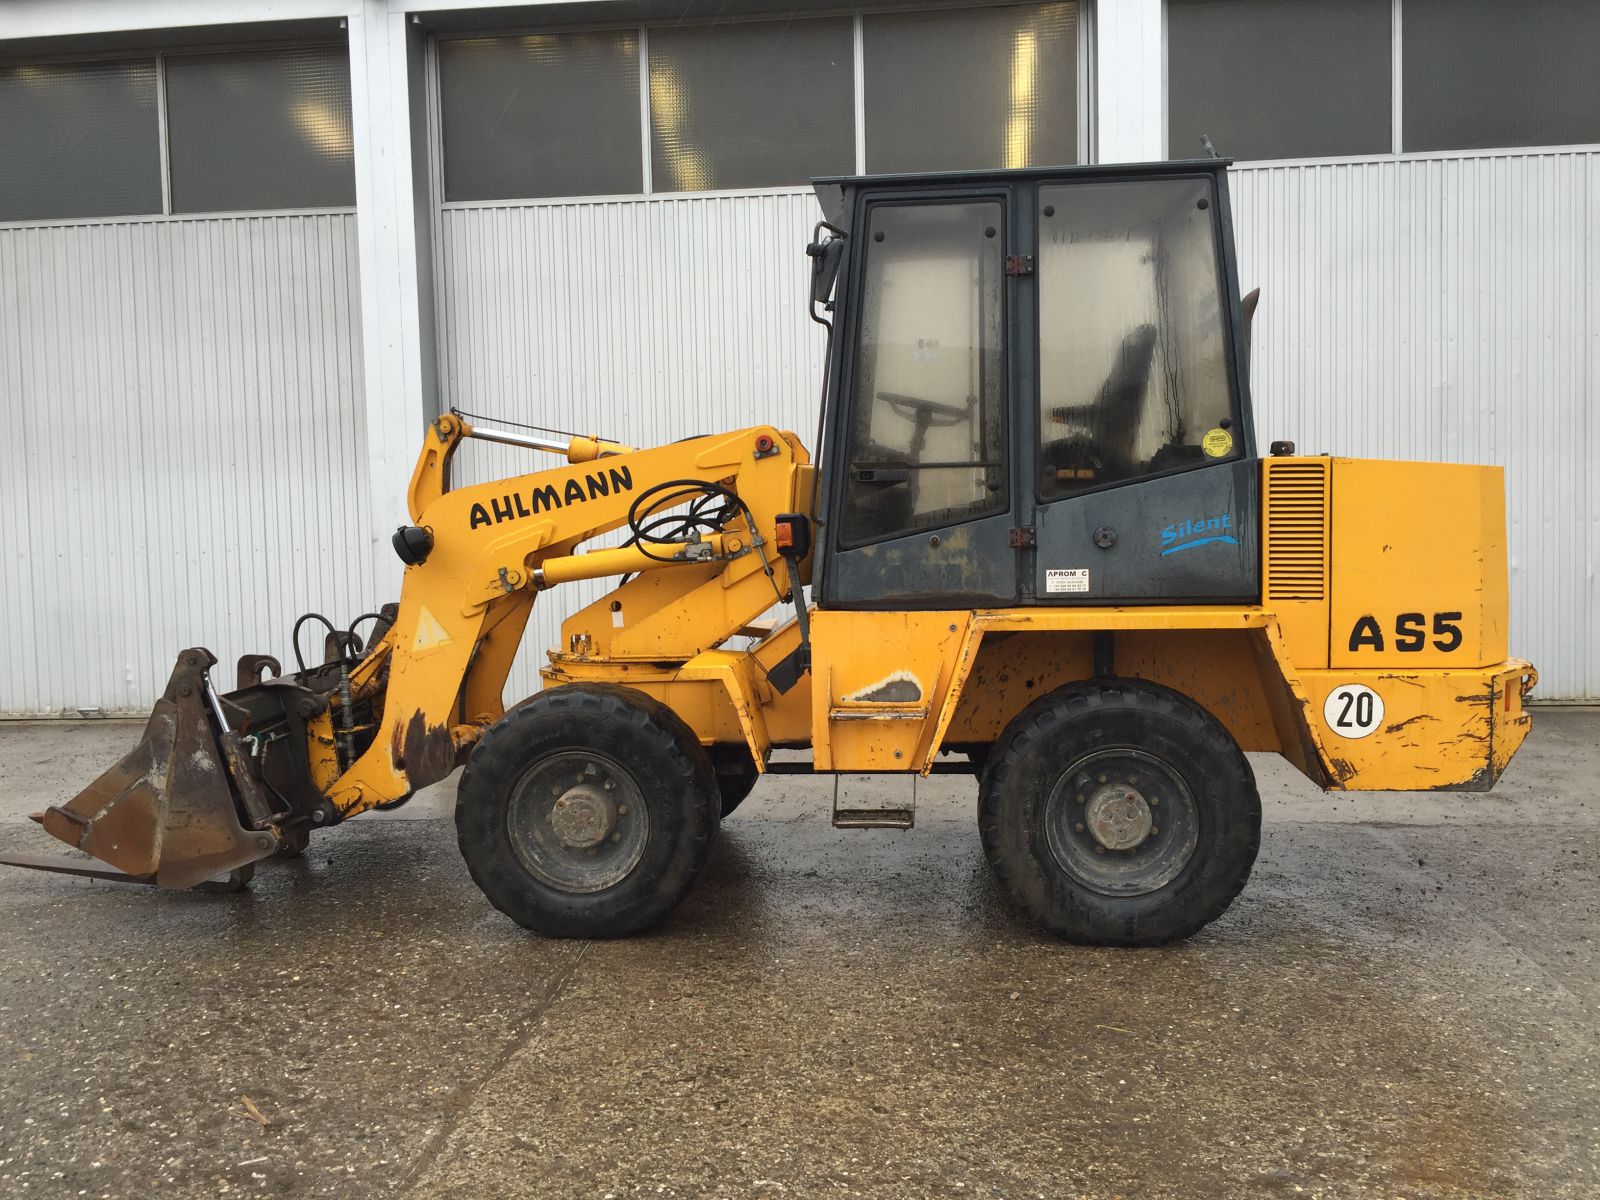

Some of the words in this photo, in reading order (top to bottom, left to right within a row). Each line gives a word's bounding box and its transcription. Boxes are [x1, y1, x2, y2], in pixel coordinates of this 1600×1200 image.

[470, 465, 633, 530] AHLMANN
[1161, 512, 1232, 546] Silent
[1336, 691, 1374, 728] 20
